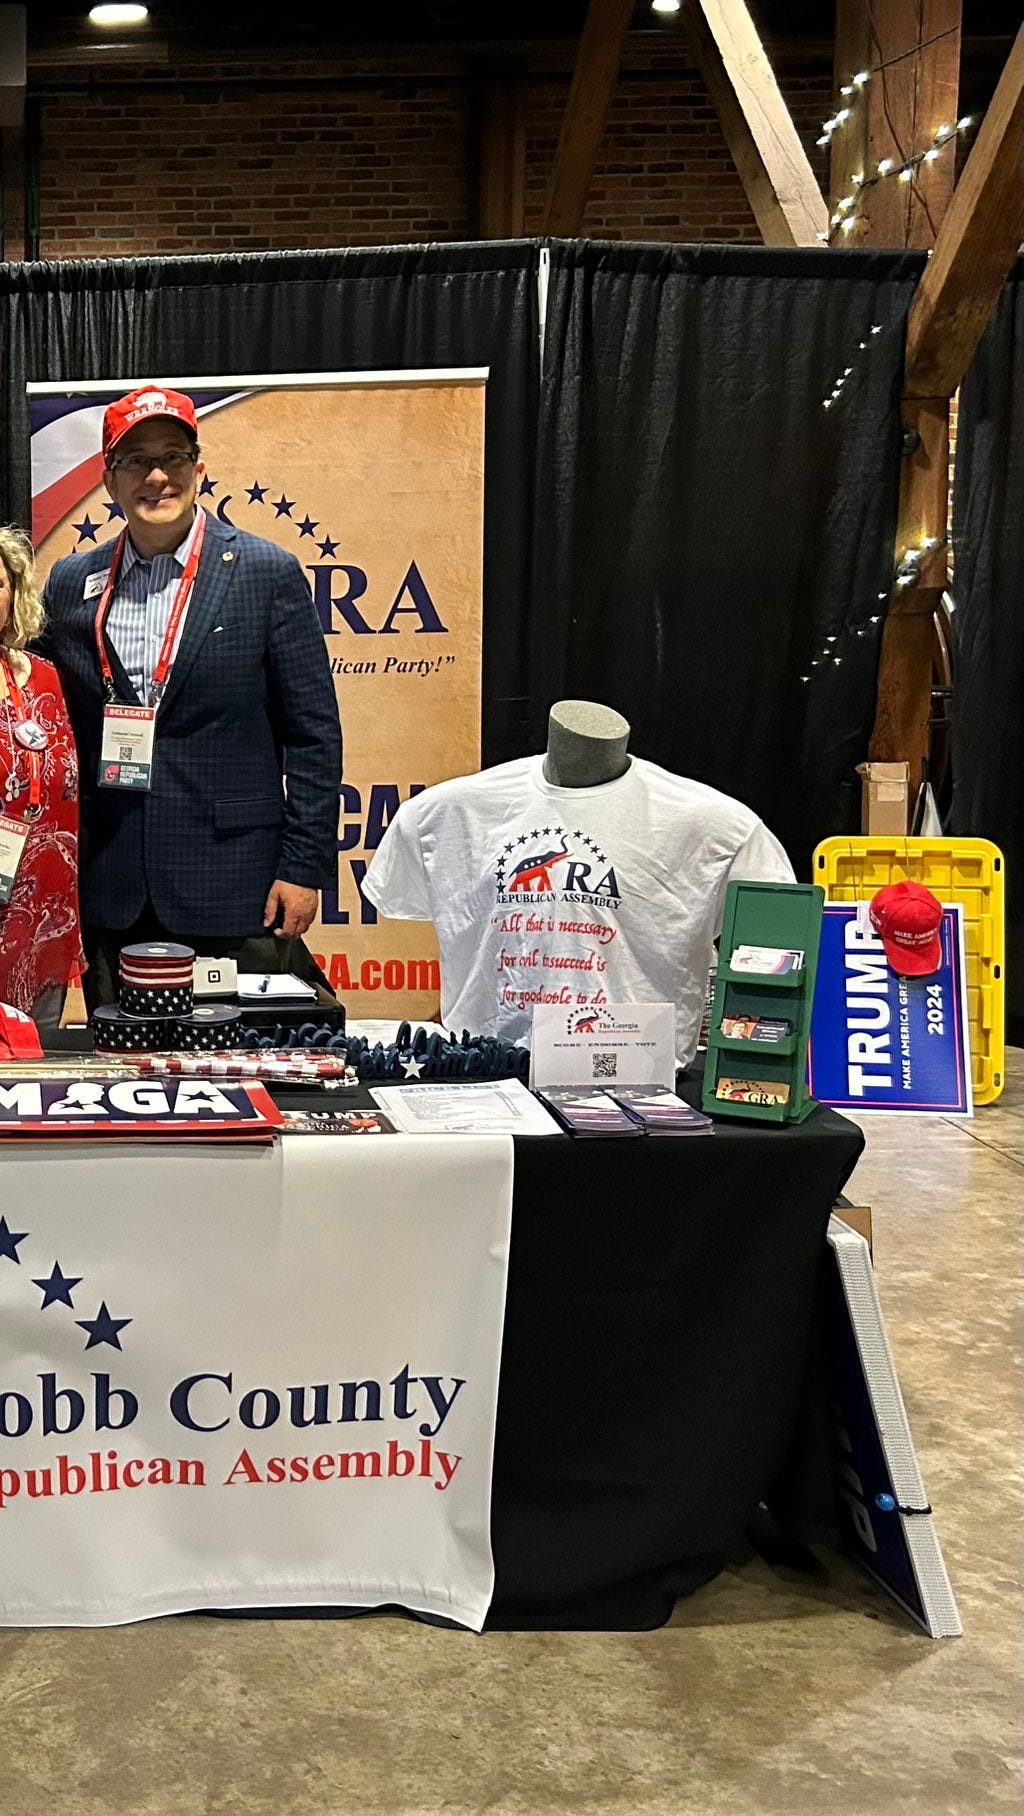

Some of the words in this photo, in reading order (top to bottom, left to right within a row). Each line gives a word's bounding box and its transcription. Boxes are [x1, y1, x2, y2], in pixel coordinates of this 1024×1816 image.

[306, 560, 450, 636] RA
[329, 656, 376, 675] lican
[109, 708, 150, 718] DELEGATE
[562, 861, 622, 899] RA
[495, 892, 557, 904] REPUBLICAN
[561, 893, 623, 910] ASSEMBLY
[558, 920, 618, 945] necessary
[894, 930, 913, 939] MAKE
[497, 948, 517, 972] for
[550, 949, 595, 972] succeed
[597, 956, 608, 972] is
[499, 982, 517, 1006] for
[519, 984, 543, 1010] good
[576, 991, 588, 1005] to
[844, 919, 894, 1098] TRUMP
[926, 984, 944, 1036] 2024
[612, 1022, 638, 1030] Georgia
[899, 1007, 911, 1057] AMERICA
[901, 1059, 912, 1090] MAKE
[748, 1092, 778, 1105] GRA
[169, 1363, 468, 1436] County
[223, 1438, 464, 1491] Assembly
